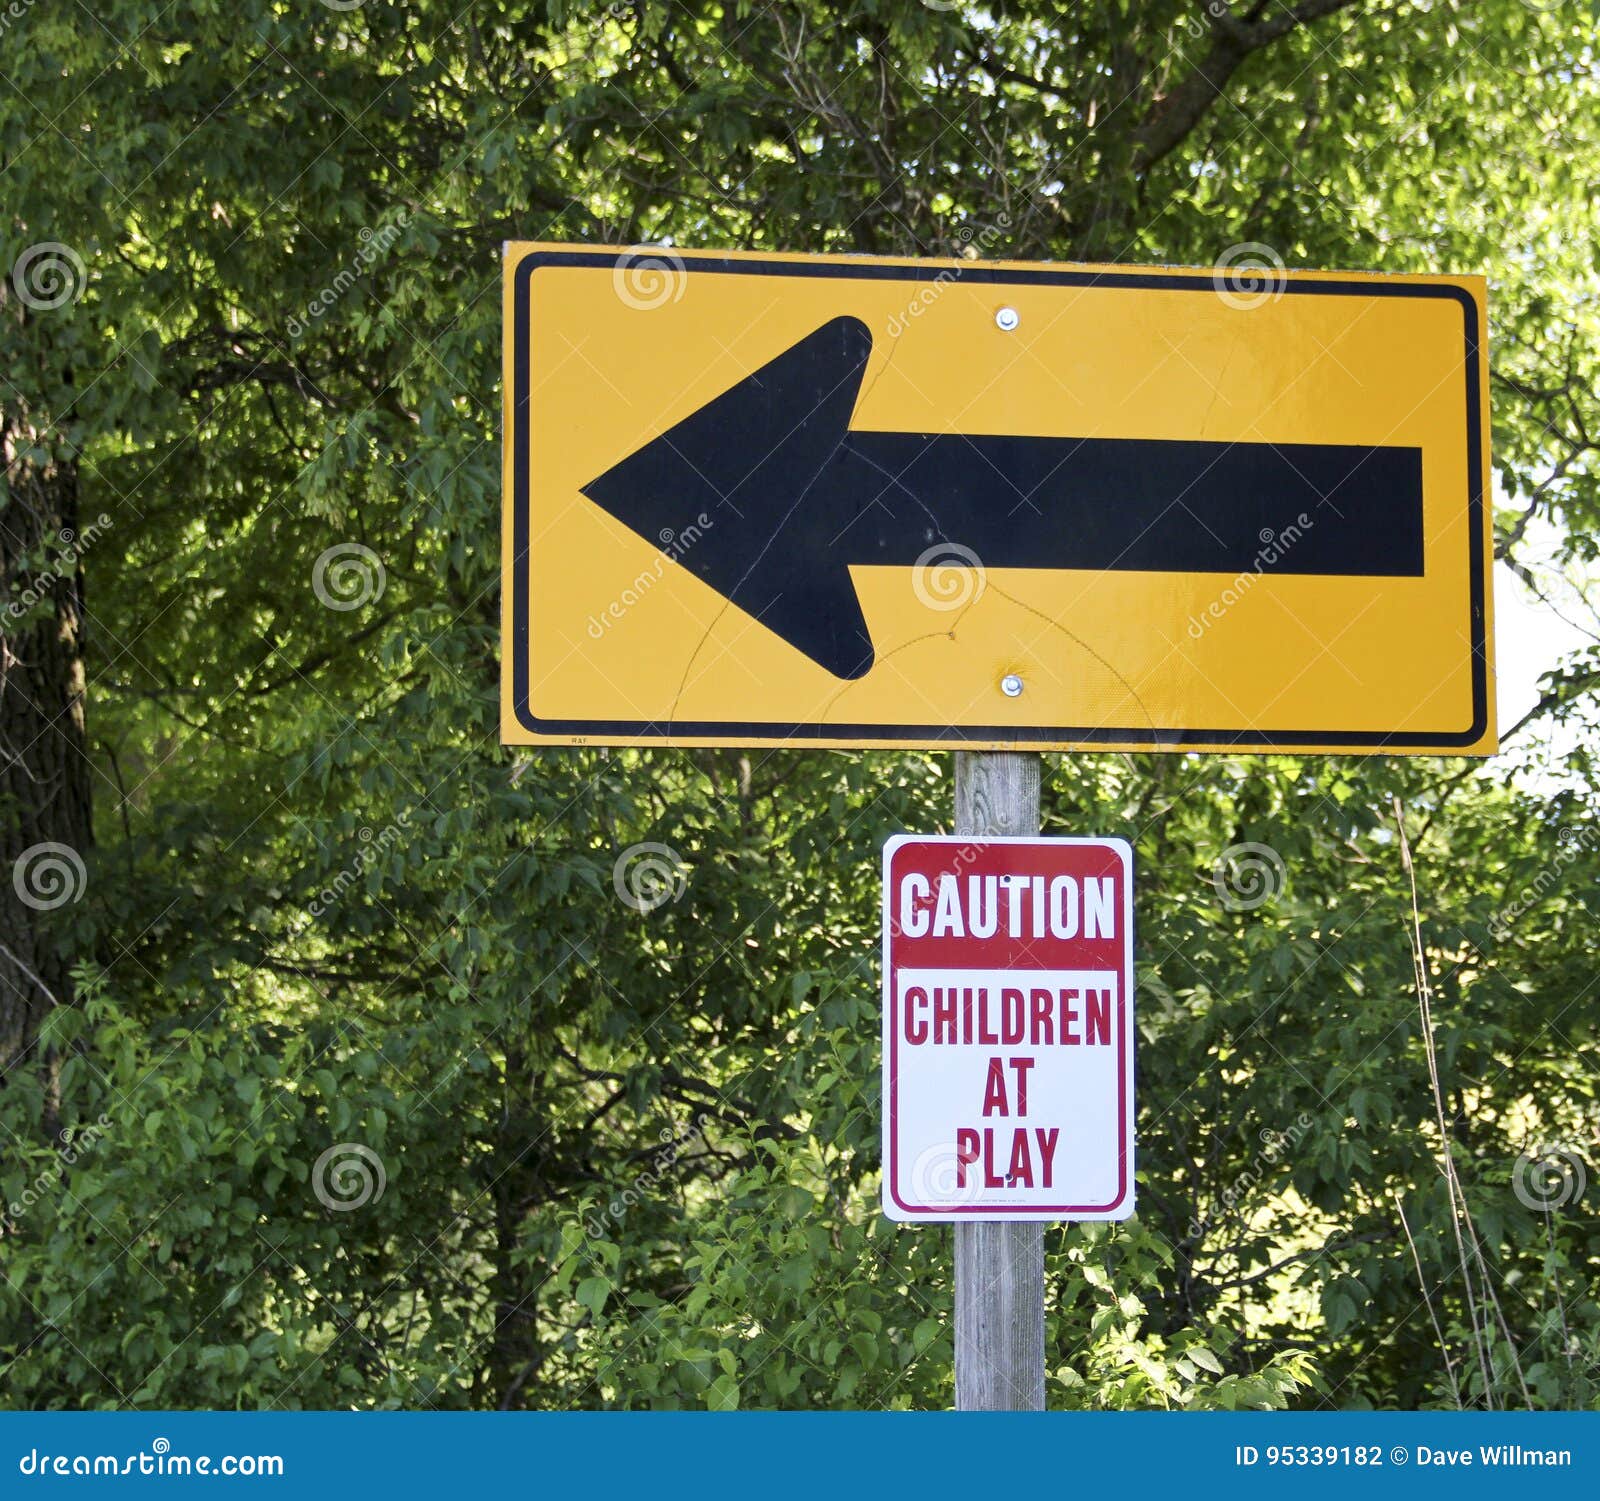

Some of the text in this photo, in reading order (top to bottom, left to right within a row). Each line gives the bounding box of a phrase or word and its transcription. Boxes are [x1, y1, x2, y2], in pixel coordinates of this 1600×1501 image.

[900, 872, 1115, 939] CAUTION
[903, 986, 1112, 1047] CHILDREN
[982, 1057, 1035, 1118] AT
[956, 1127, 1060, 1189] PLAY
